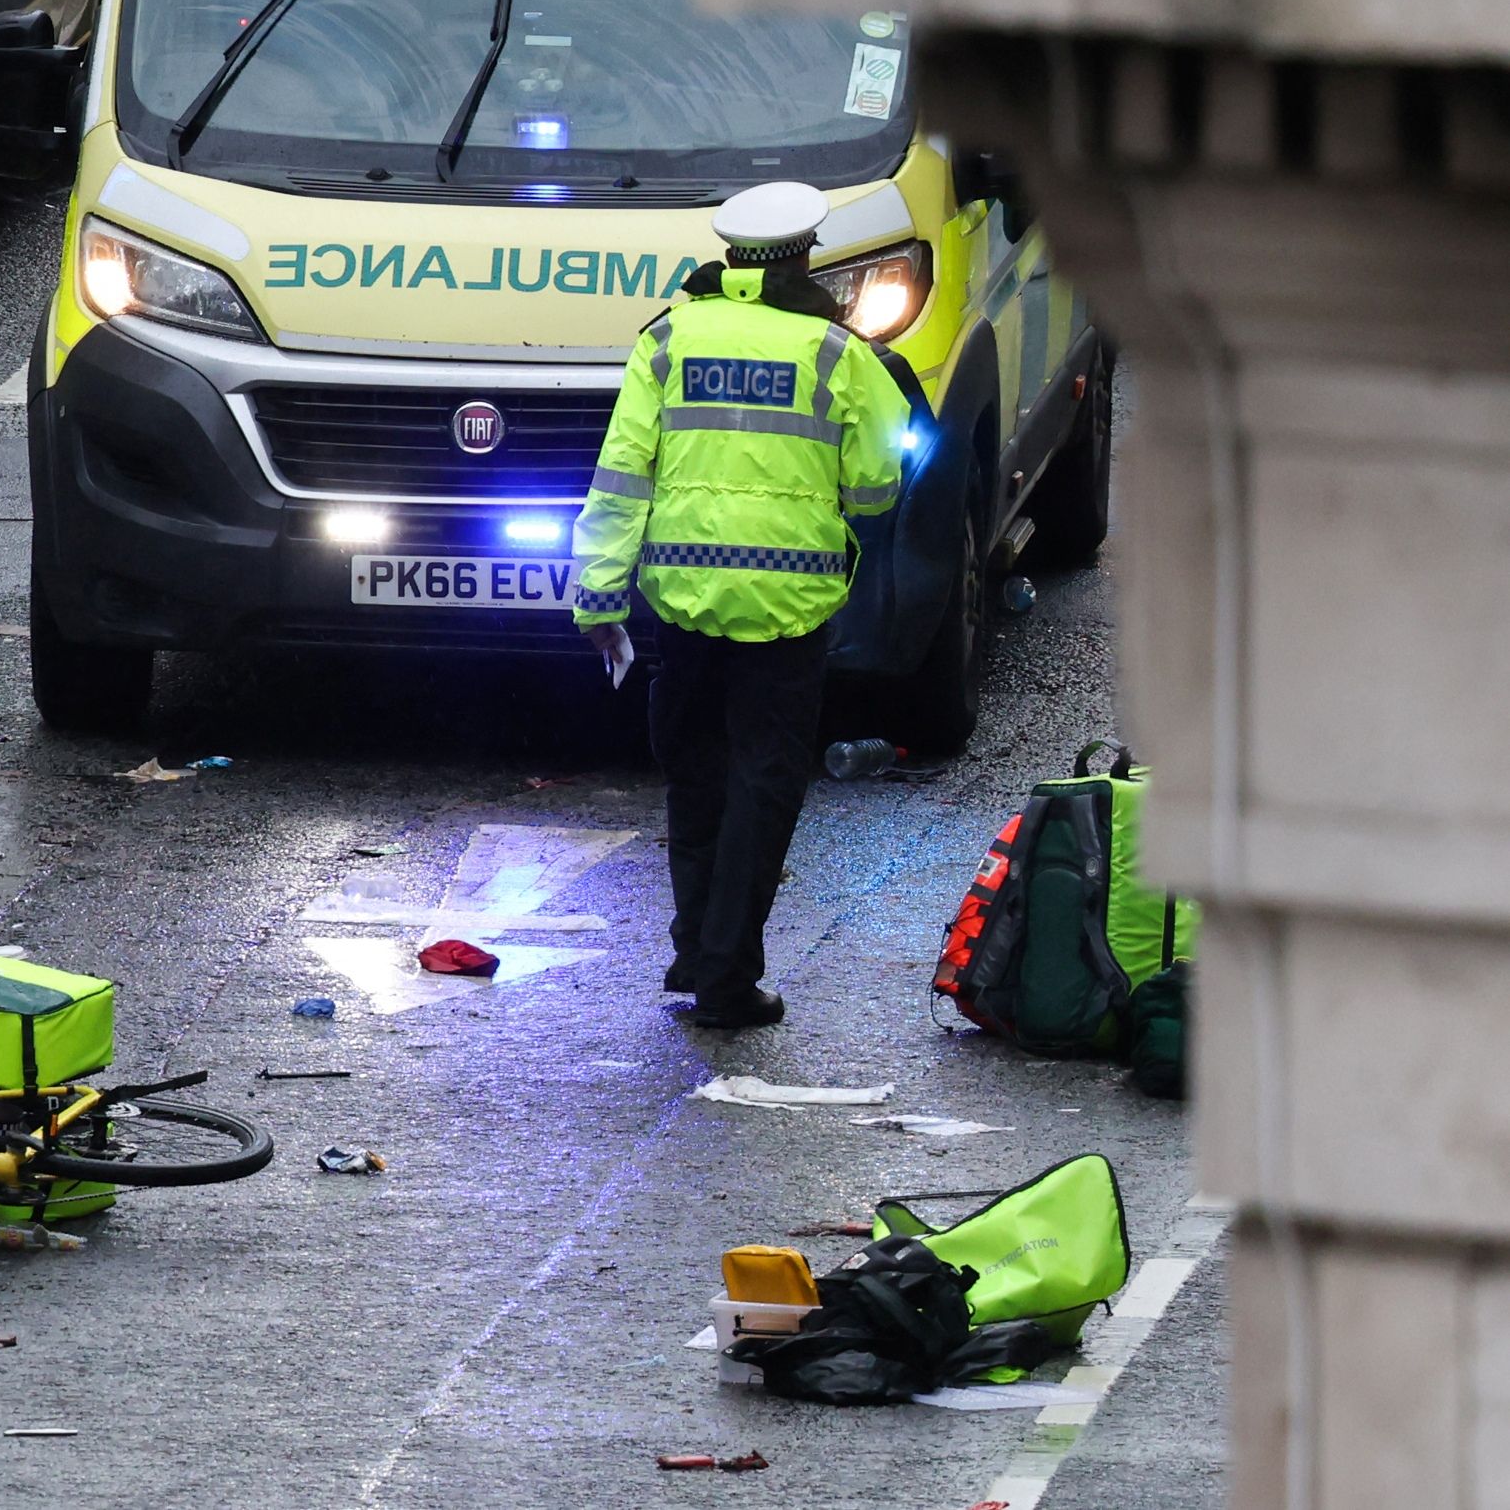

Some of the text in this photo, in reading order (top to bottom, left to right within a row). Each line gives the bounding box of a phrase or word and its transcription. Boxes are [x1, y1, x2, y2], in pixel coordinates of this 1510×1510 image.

[687, 365, 791, 399] POLICE
[463, 416, 495, 442] FIAT
[369, 560, 571, 602] PK66 ECV
[985, 1237, 1059, 1276] EXTRICATION
